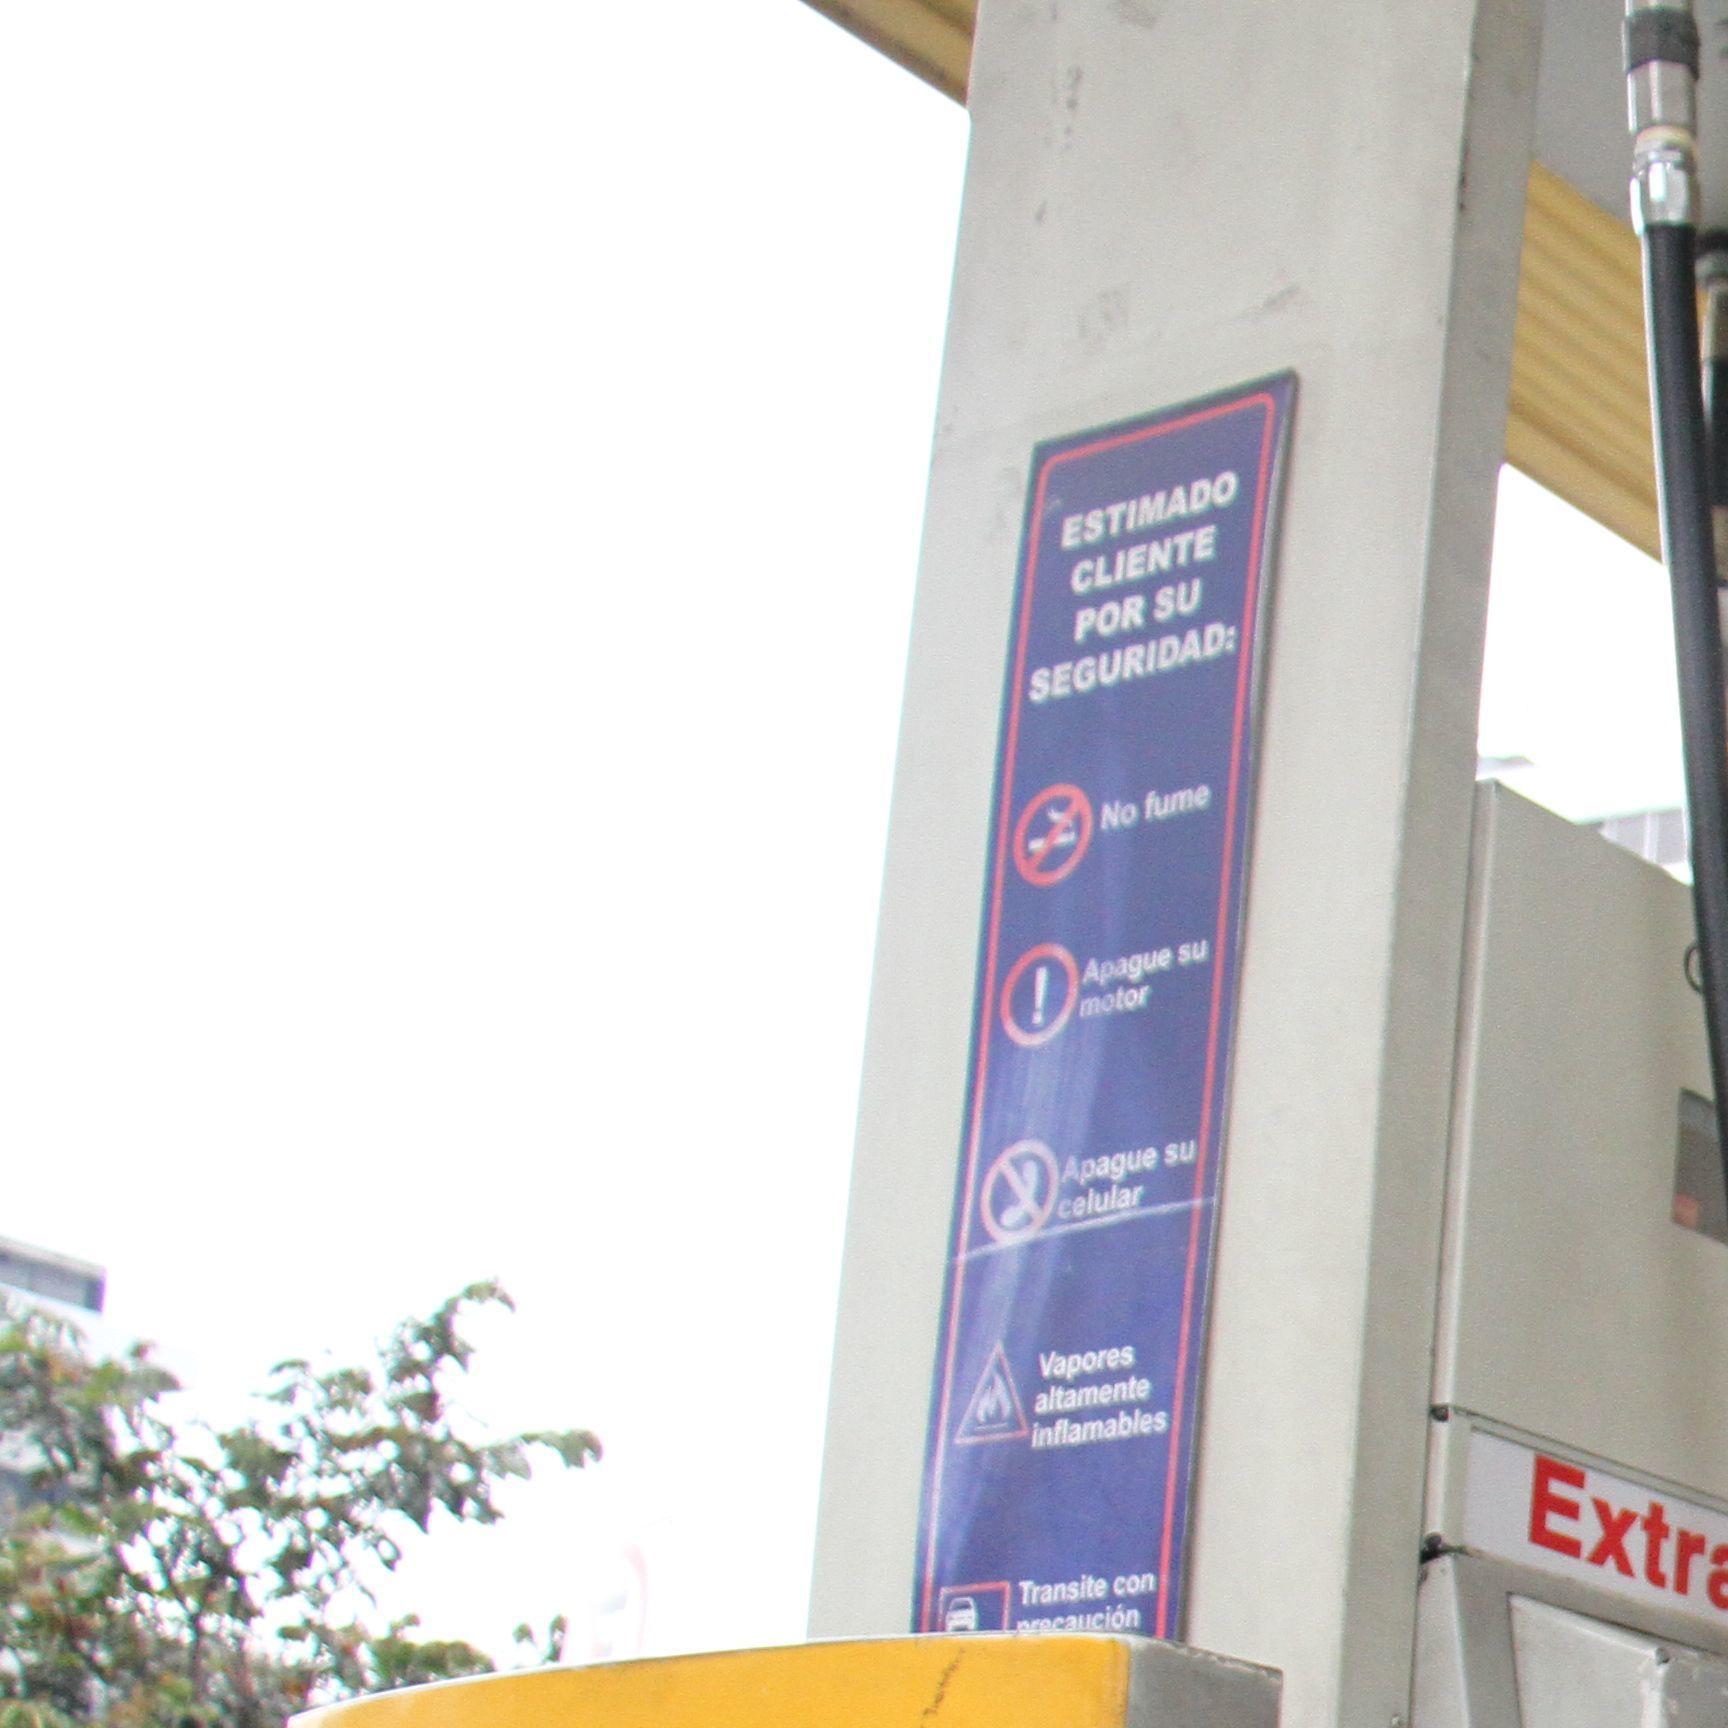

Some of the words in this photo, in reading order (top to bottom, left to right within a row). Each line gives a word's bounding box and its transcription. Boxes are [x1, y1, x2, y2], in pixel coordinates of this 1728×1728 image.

[1061, 471, 1239, 550] ESTIMADO
[1071, 525, 1216, 594] CLIENTE
[1074, 595, 1145, 643] POR
[1154, 578, 1200, 621] SU
[1028, 622, 1236, 704] SEGURIDAD:
[1100, 802, 1138, 831] No
[1145, 784, 1210, 821] fume
[1082, 945, 1171, 985] Apague
[1178, 938, 1208, 964] su
[1079, 983, 1149, 1019] motor
[1061, 1146, 1157, 1186] Apague
[1164, 1139, 1196, 1166] su
[1057, 1184, 1144, 1219] celular
[1039, 1345, 1136, 1380] Vapores
[1034, 1376, 1151, 1414] altamente
[1031, 1409, 1169, 1450] inflamables
[1018, 1574, 1108, 1606] Transite
[1113, 1572, 1156, 1597] con
